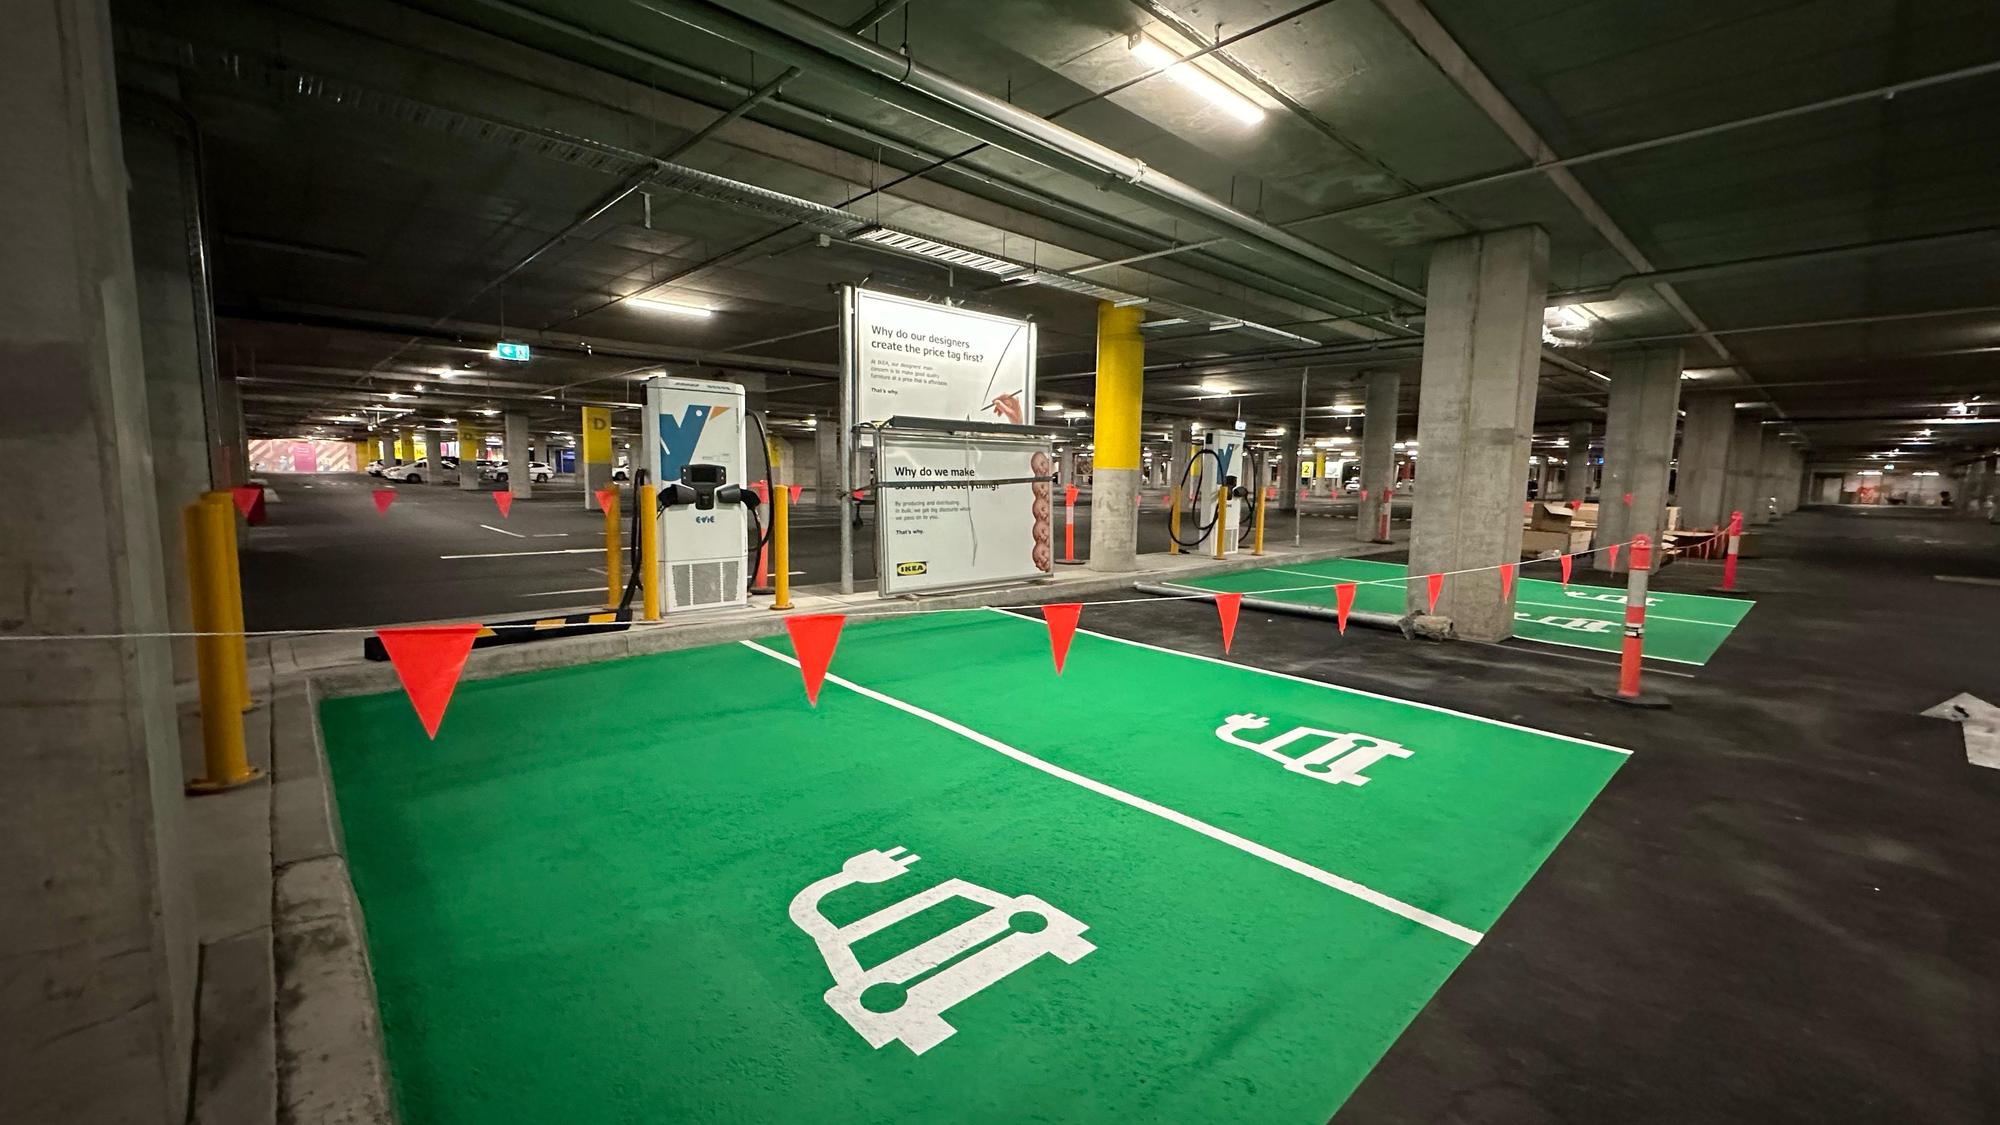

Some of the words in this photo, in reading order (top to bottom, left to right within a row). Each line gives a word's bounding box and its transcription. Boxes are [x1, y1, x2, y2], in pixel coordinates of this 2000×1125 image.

[871, 325, 893, 339] Why
[896, 329, 908, 339] do
[911, 333, 926, 341] our
[929, 334, 970, 349] designers
[871, 340, 902, 352] create
[905, 343, 921, 354] the
[923, 346, 945, 357] price
[947, 349, 961, 362] tag
[963, 352, 984, 363] first?
[594, 418, 607, 431] D
[894, 466, 917, 478] Why
[919, 467, 932, 476] do
[950, 467, 975, 476] make
[900, 565, 924, 573] IKEA
